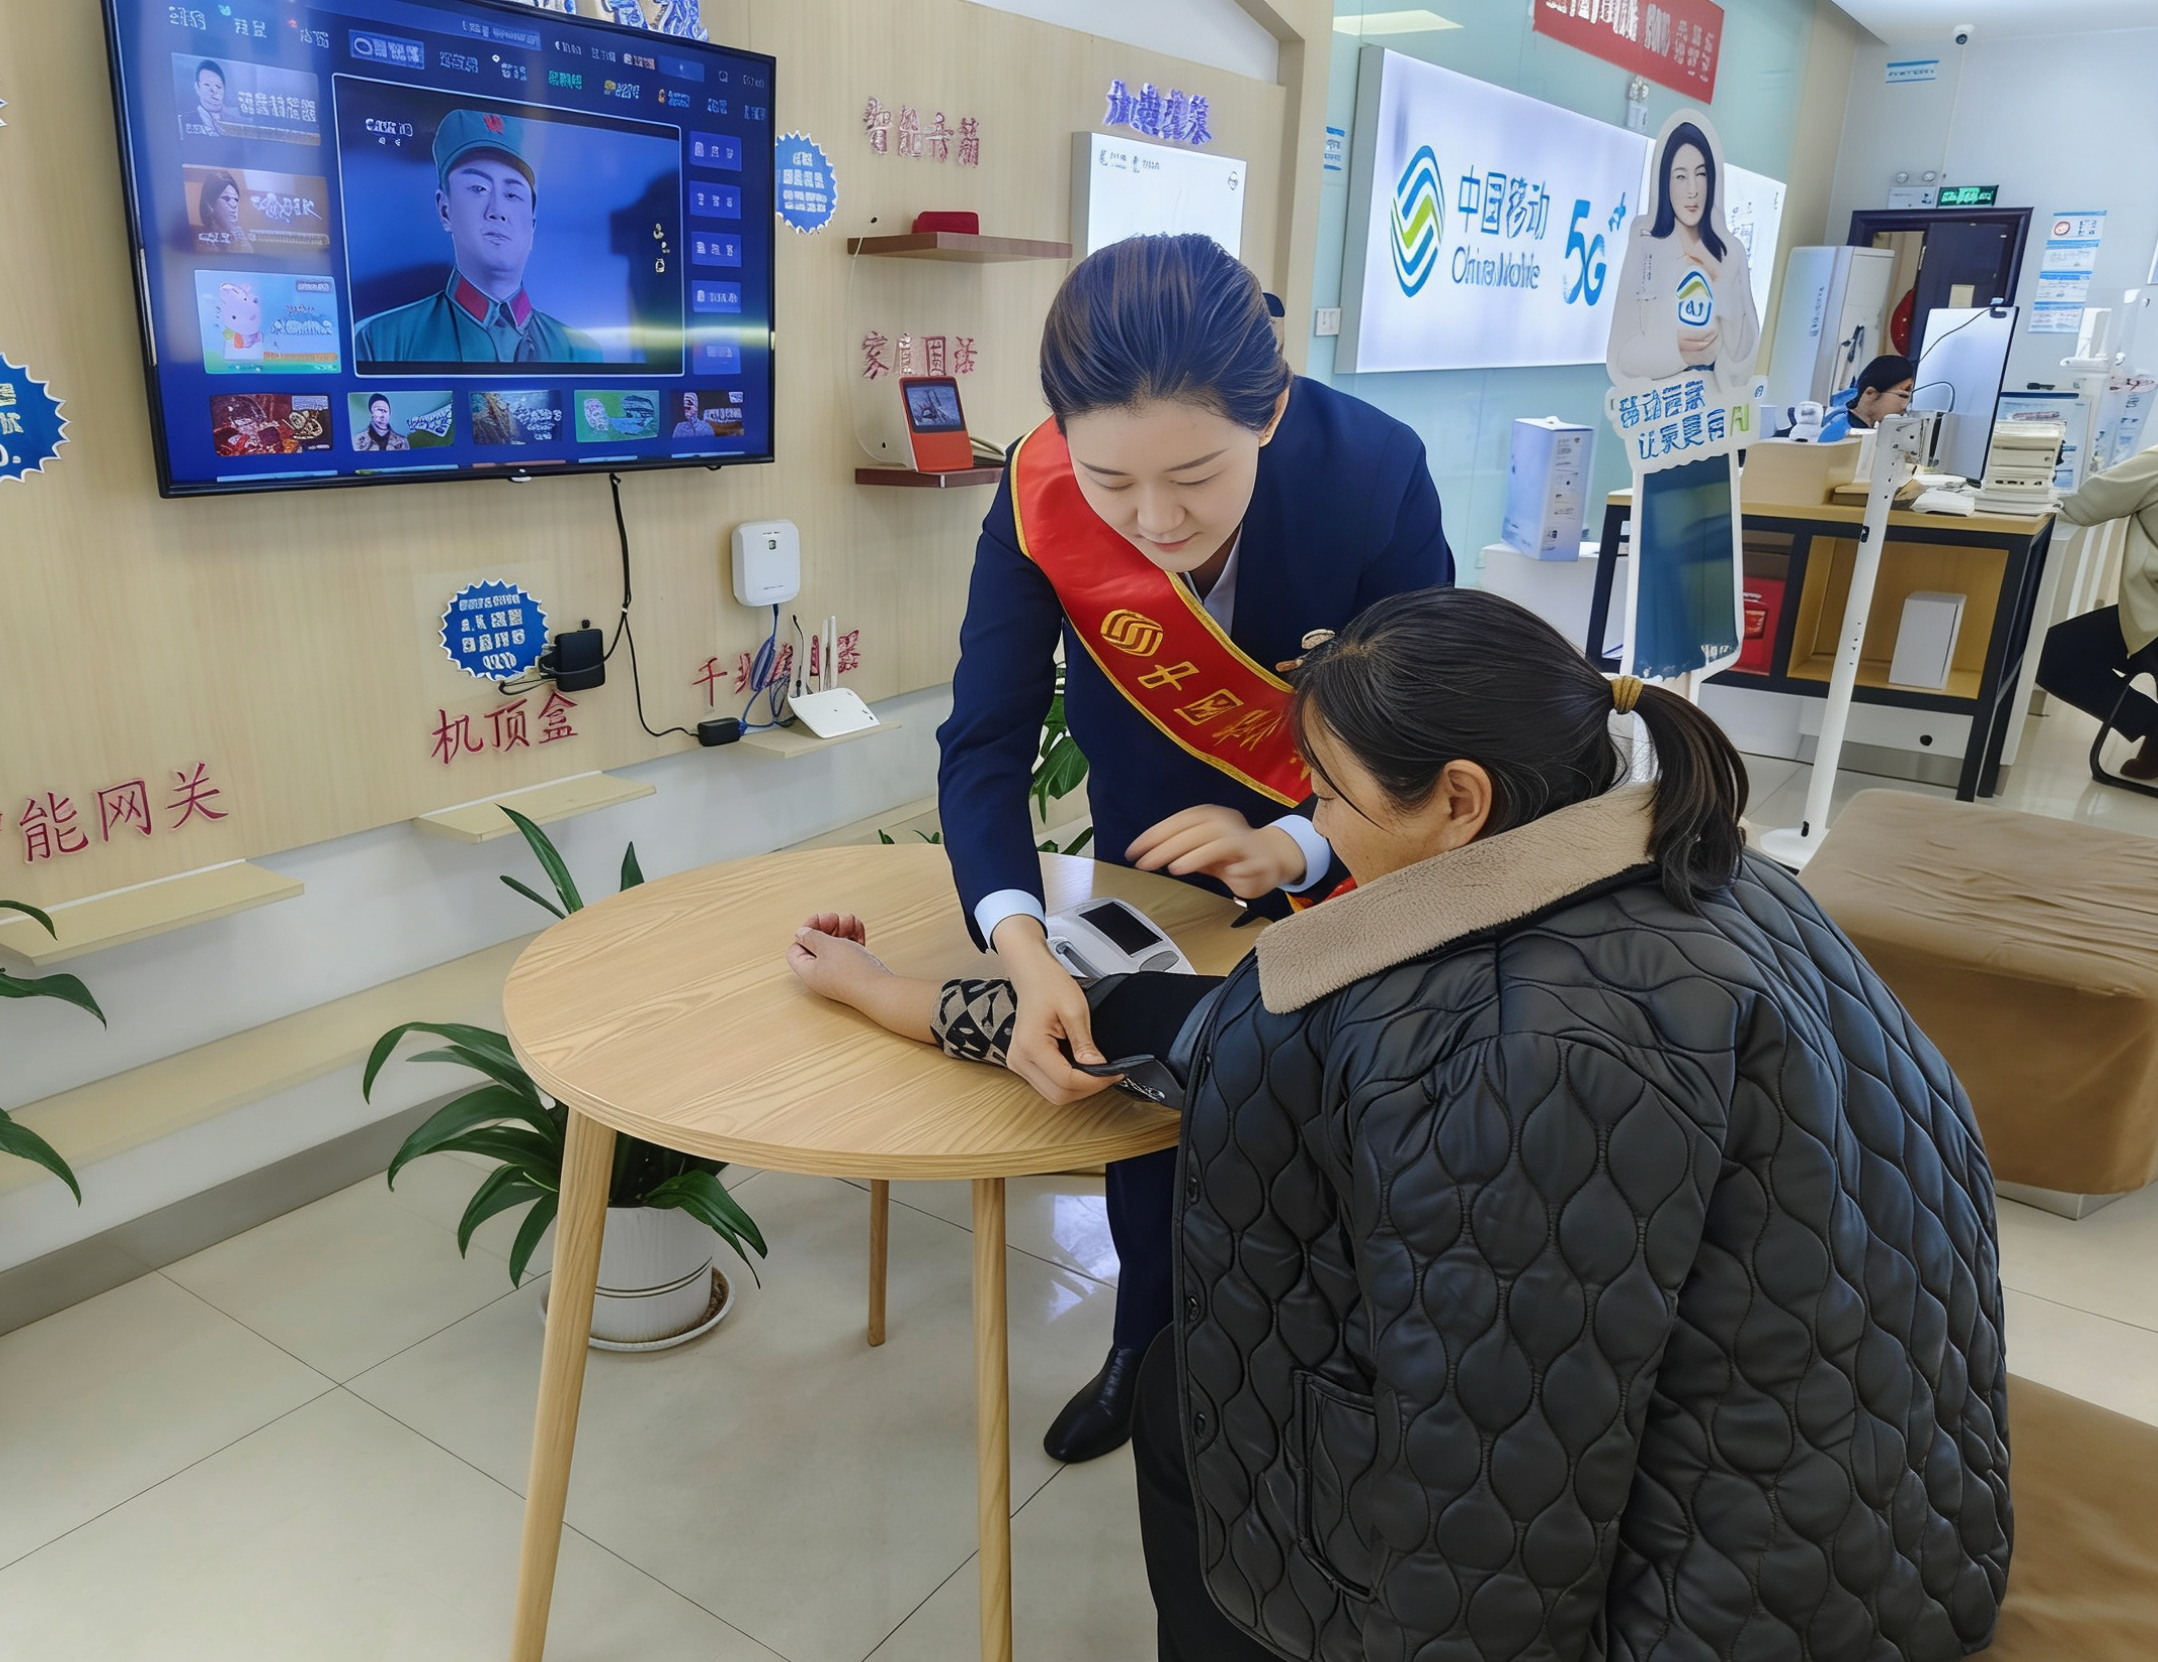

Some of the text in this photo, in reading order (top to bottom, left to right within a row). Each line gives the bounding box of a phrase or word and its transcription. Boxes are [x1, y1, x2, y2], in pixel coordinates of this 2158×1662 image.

[1458, 165, 1550, 240] 中国移动
[431, 690, 579, 765] 机顶盒
[0, 762, 230, 863] 能网关
